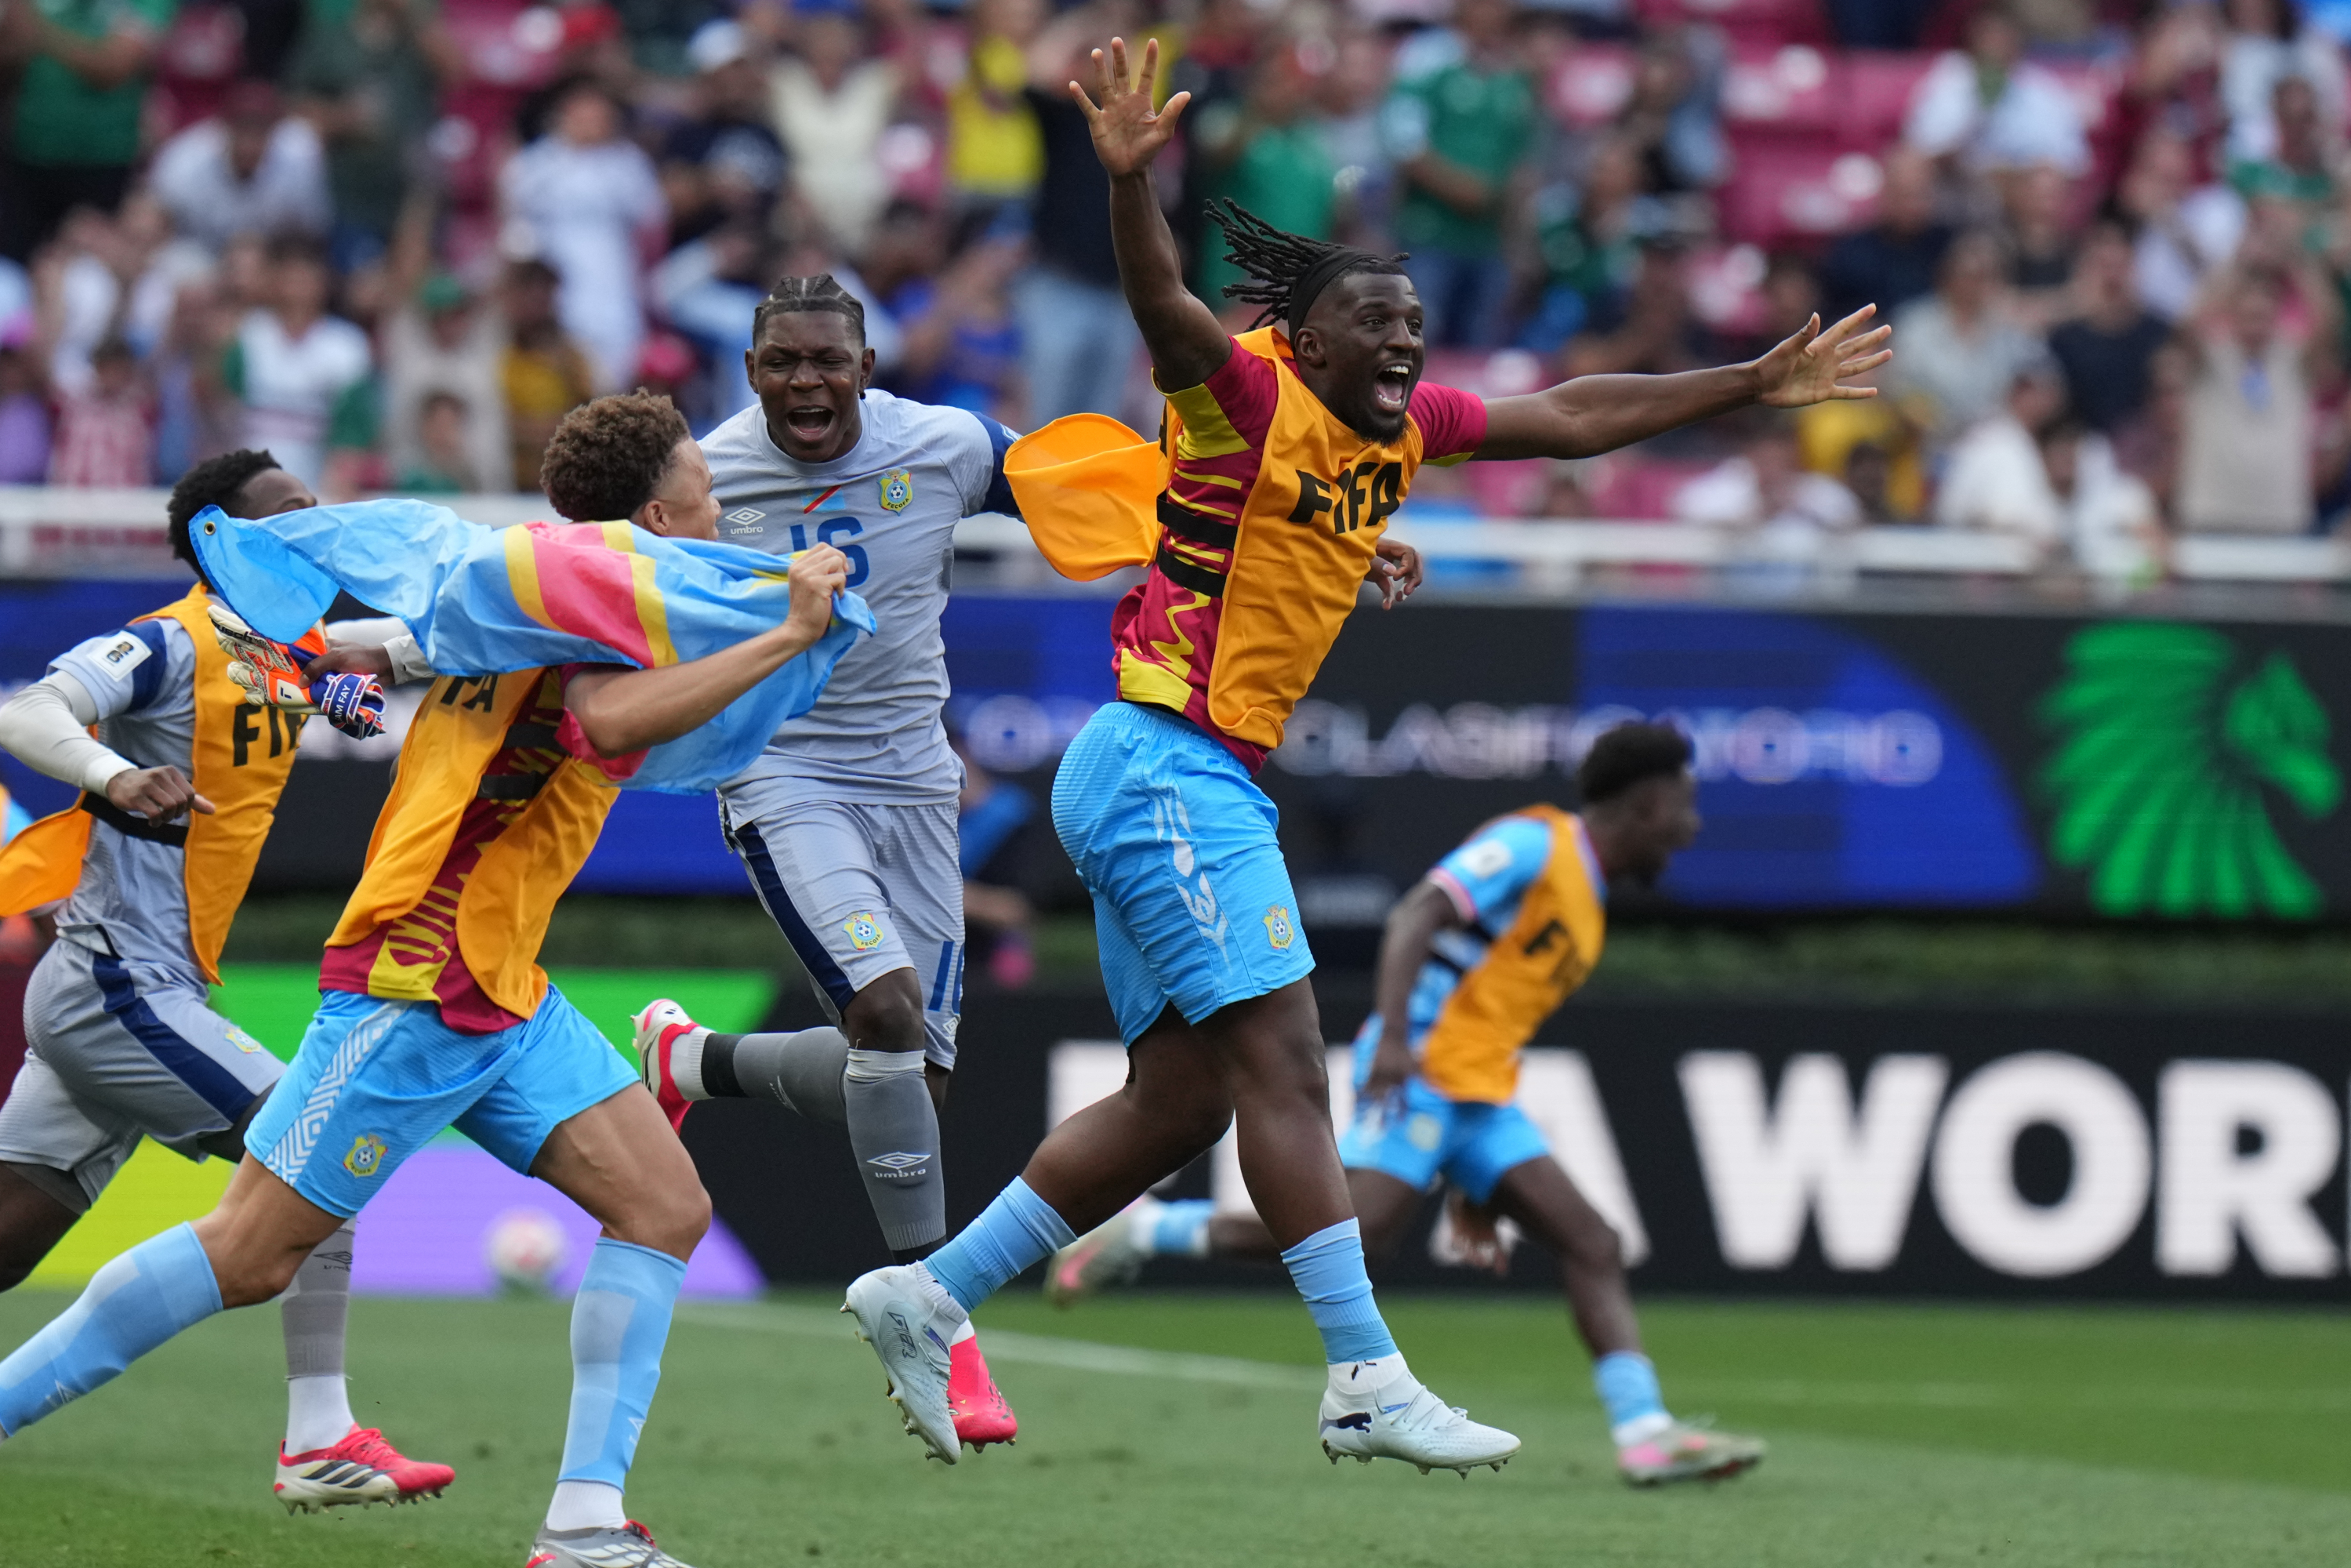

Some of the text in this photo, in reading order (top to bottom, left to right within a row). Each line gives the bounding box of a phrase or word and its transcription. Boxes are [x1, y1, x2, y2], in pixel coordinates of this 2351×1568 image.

[887, 498, 909, 509] FECOFA
[1287, 461, 1402, 535] FIFA
[730, 525, 764, 535] umbro
[338, 684, 351, 704] FAY
[861, 934, 881, 946] FECOFA
[1275, 934, 1292, 946] FECOFA
[1674, 1049, 2351, 1279] WOR
[875, 1168, 927, 1178] umbro
